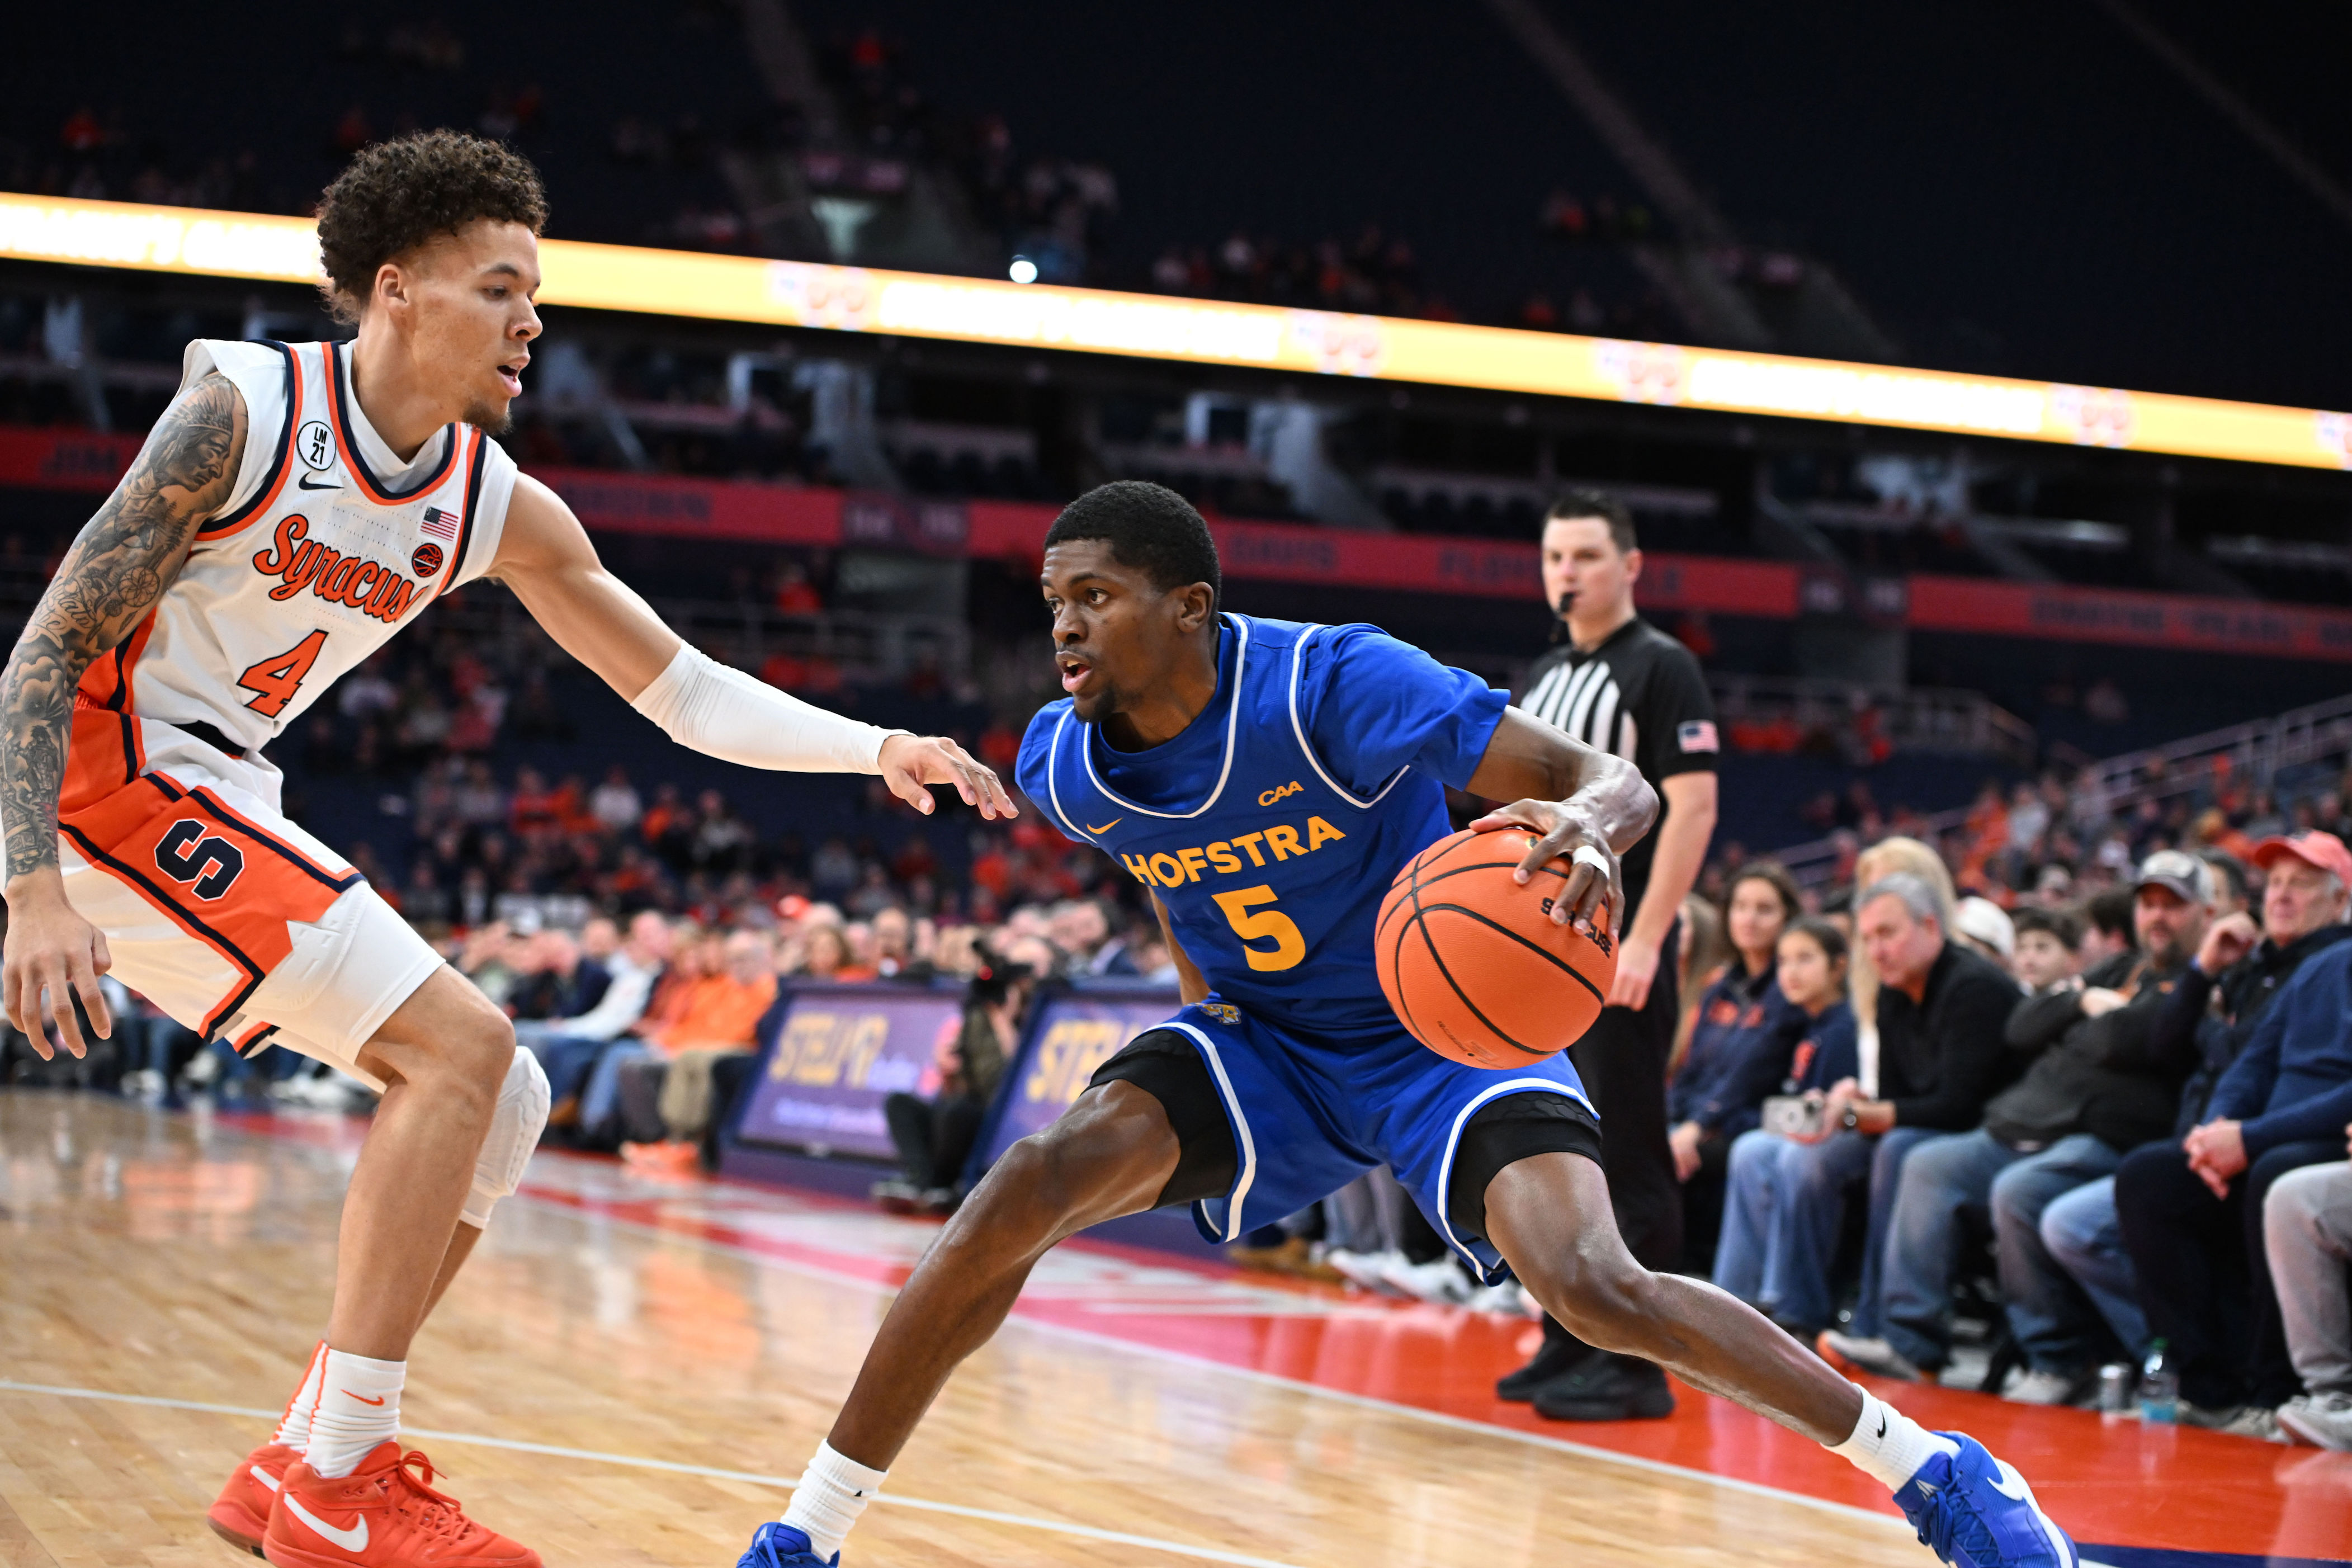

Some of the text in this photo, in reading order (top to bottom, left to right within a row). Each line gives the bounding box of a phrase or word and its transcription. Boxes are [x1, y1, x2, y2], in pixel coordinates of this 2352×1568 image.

[310, 442, 325, 465] 21
[314, 427, 327, 445] LM
[417, 554, 441, 566] ACC
[236, 628, 329, 719] 4
[1258, 781, 1305, 806] CAA
[154, 818, 244, 902] S
[1121, 815, 1347, 888] HOFSTRA
[1211, 884, 1306, 972] 5
